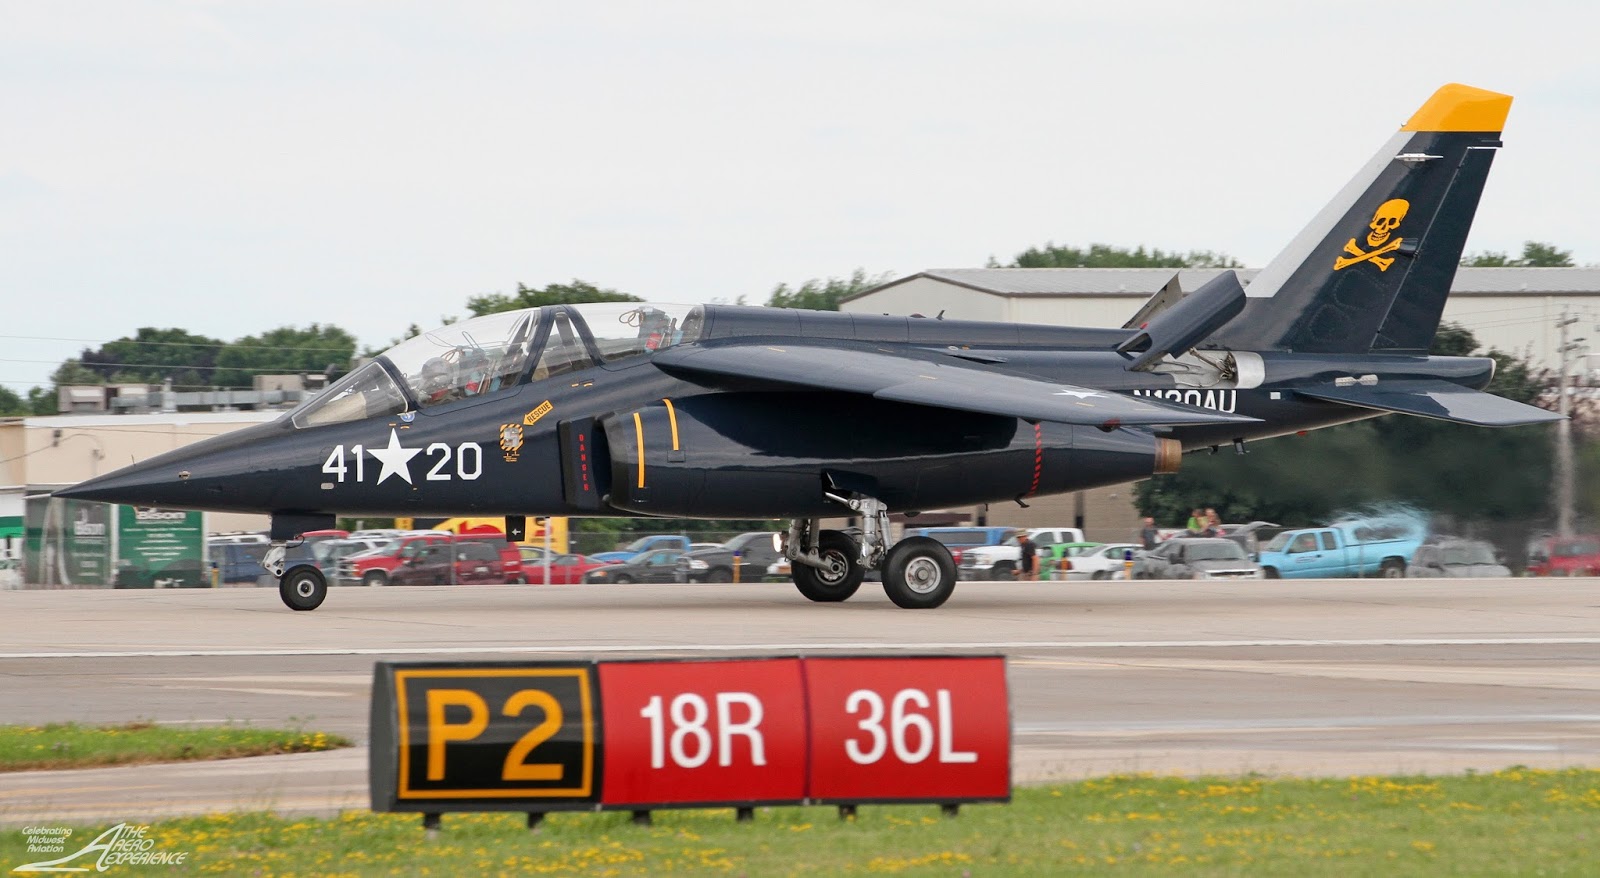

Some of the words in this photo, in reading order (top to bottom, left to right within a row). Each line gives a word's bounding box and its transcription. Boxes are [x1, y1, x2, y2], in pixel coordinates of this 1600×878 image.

[526, 402, 551, 423] RESCUE
[322, 444, 364, 482] 41
[426, 442, 482, 480] 20
[578, 433, 590, 491] DANGER
[427, 688, 563, 781] P2
[641, 691, 767, 769] 18R
[845, 688, 978, 765] 36L
